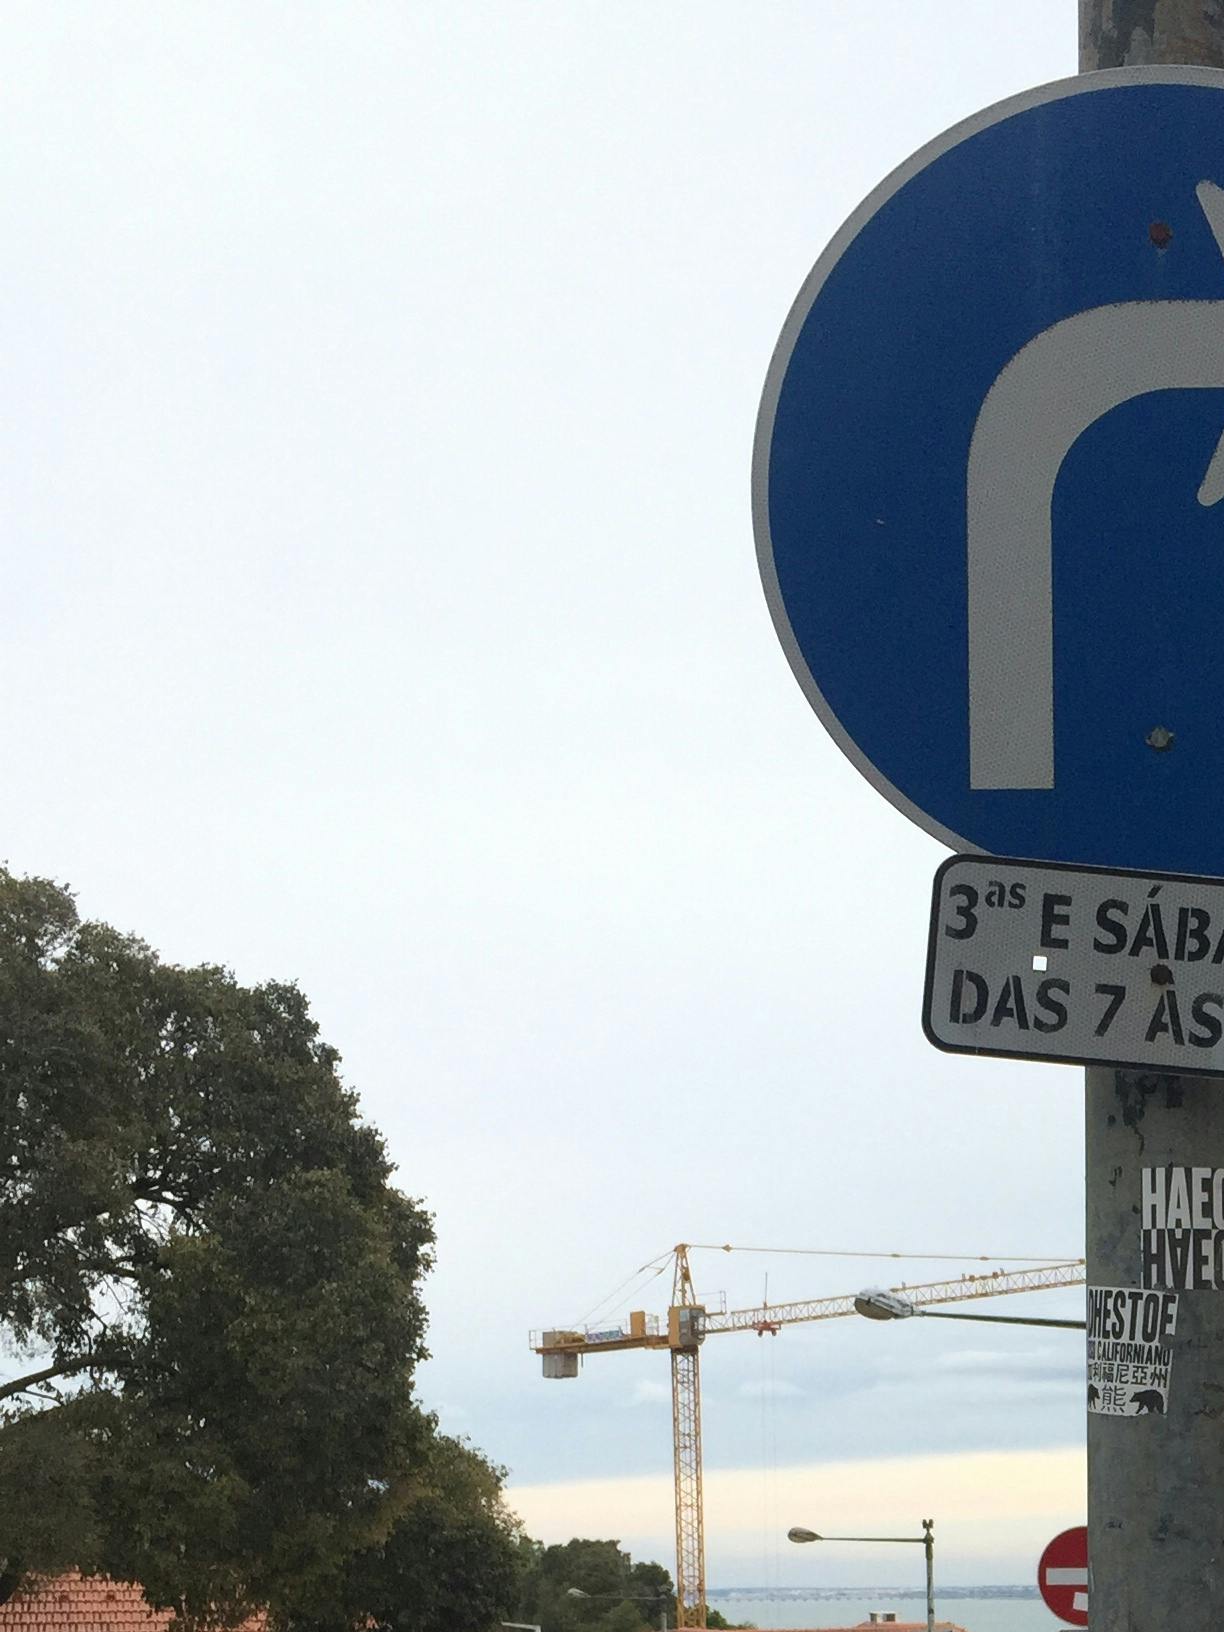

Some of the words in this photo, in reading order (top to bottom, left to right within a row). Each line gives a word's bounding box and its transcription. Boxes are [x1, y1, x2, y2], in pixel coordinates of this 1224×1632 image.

[1040, 892, 1072, 949] E
[949, 969, 1071, 1033] DAS
[1094, 983, 1127, 1037] 7
